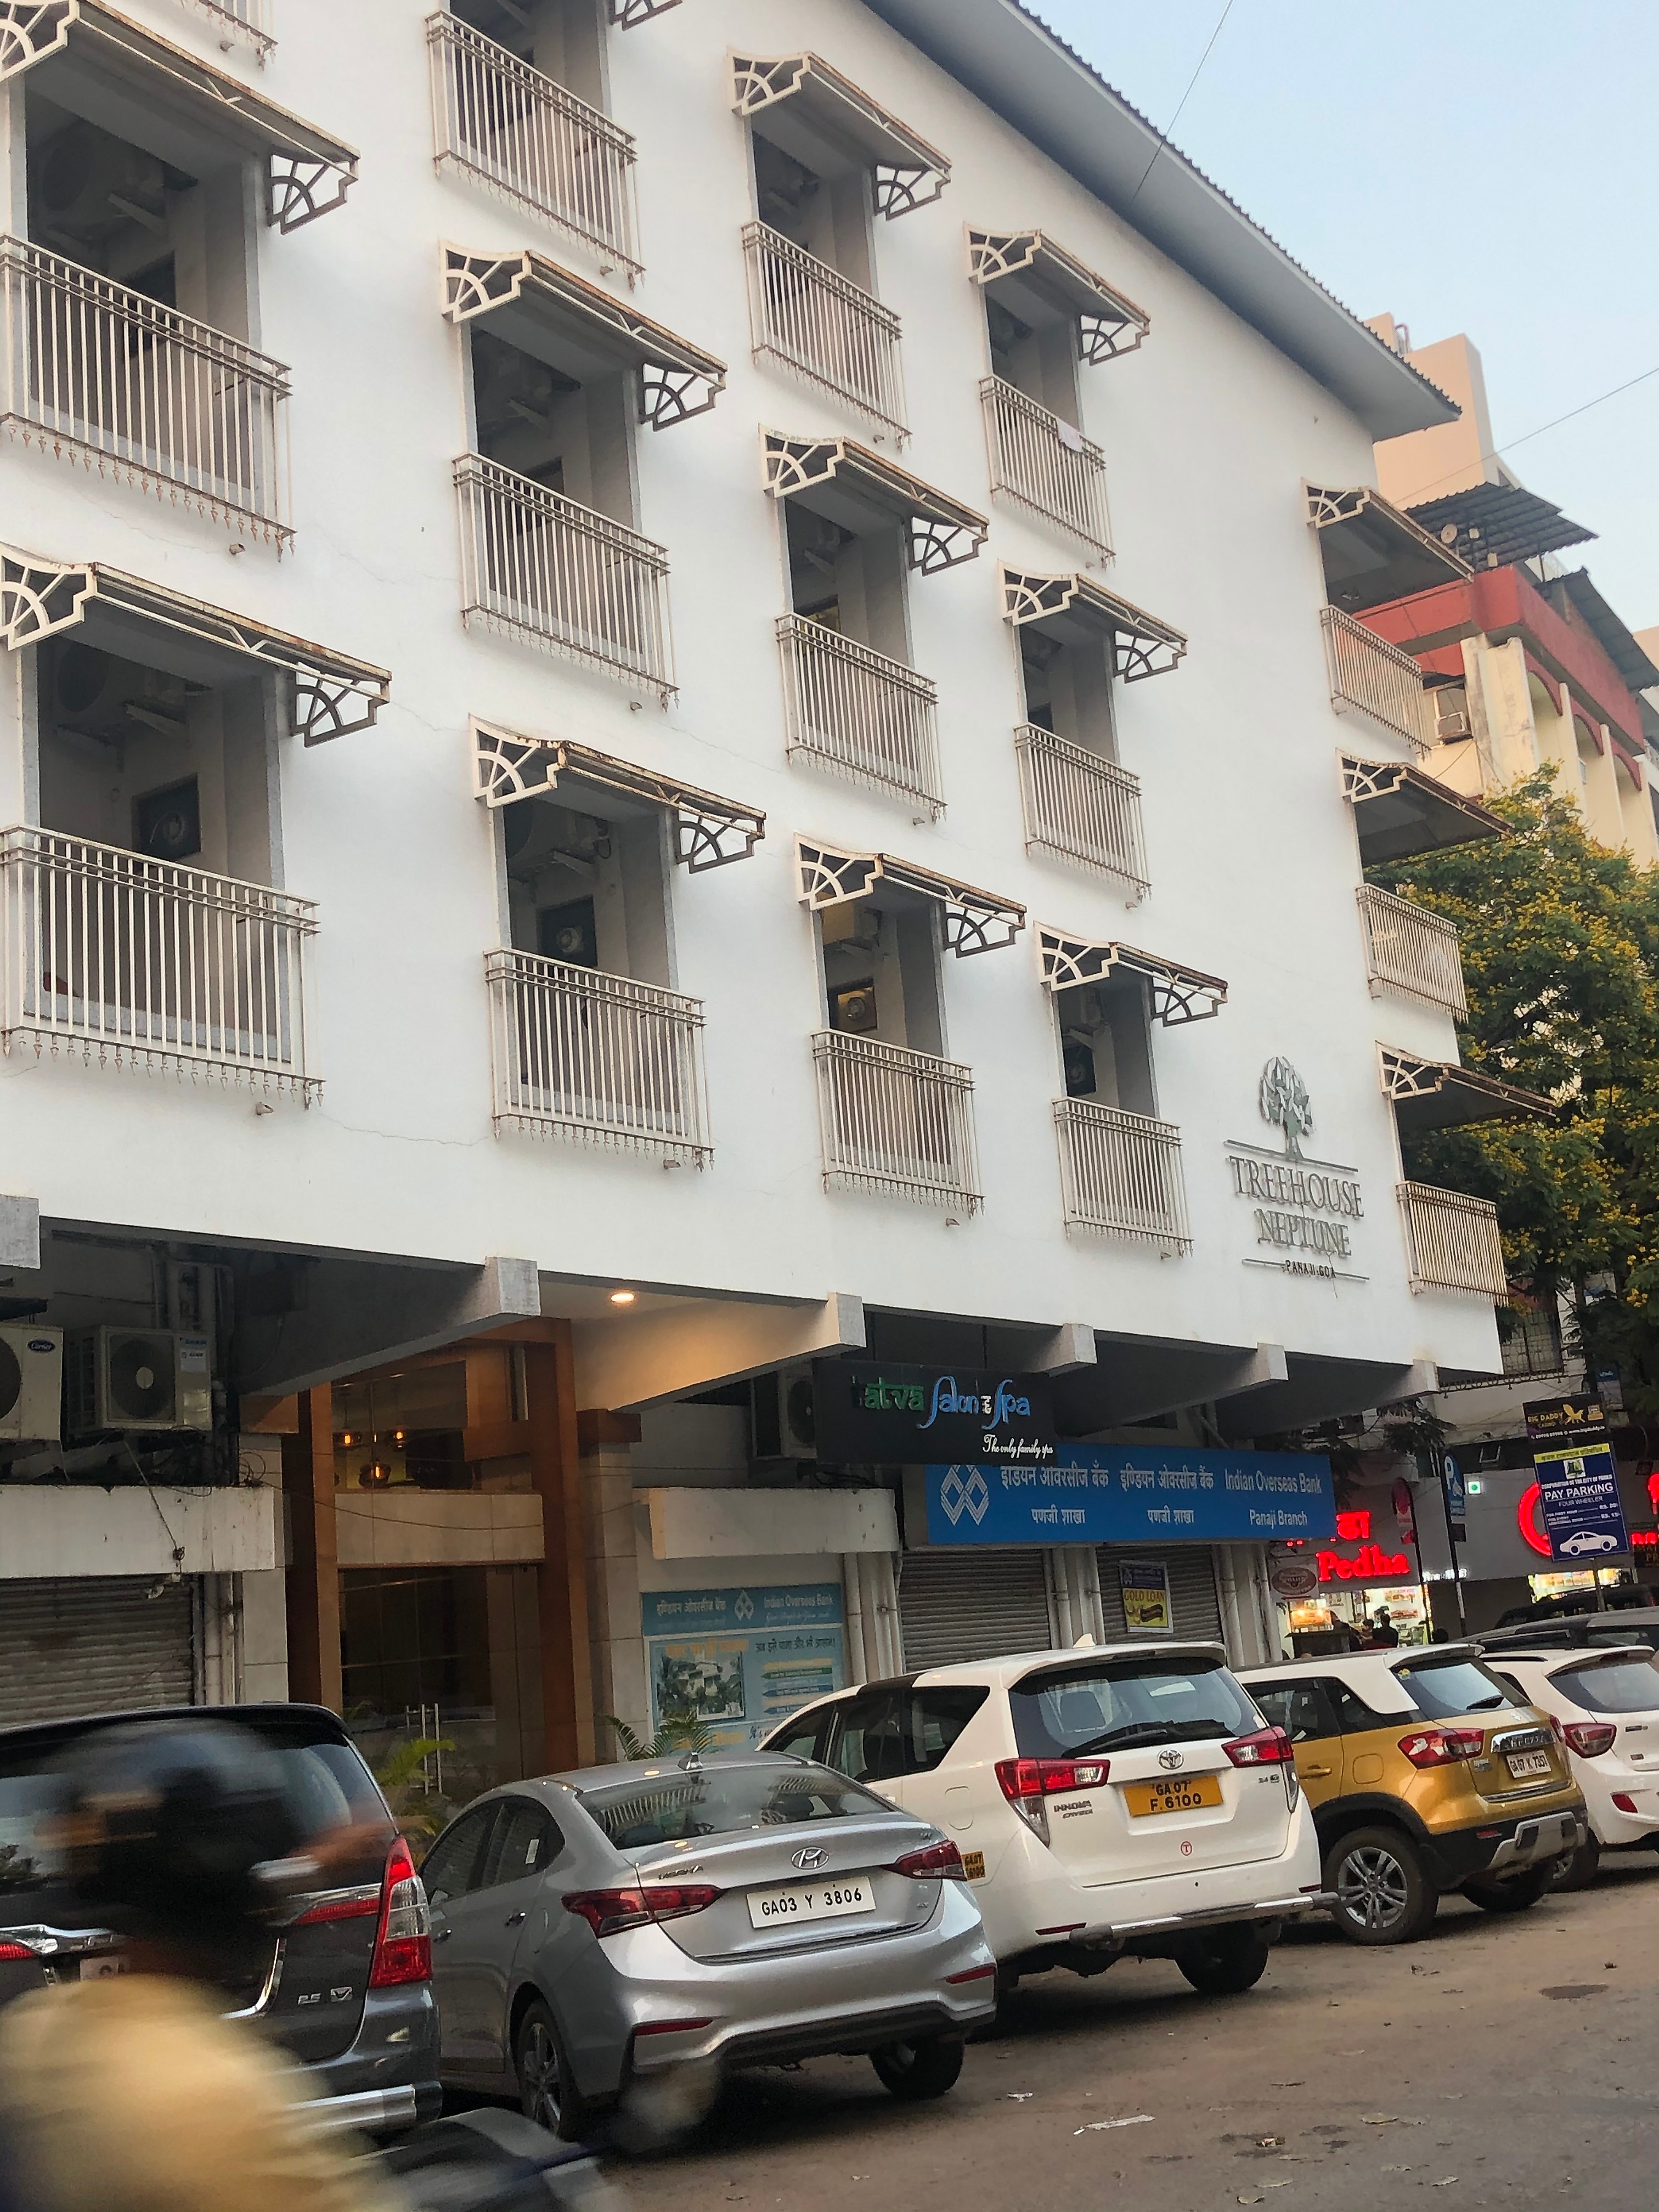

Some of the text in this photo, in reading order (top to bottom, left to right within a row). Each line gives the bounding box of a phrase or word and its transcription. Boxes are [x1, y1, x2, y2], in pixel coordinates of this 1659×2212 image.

[1228, 1155, 1364, 1217] TREEHOUSE
[1254, 1209, 1352, 1257] NEPTUNE
[1540, 1412, 1564, 1421] DADDY
[983, 1434, 1000, 1452] The
[1000, 1438, 1017, 1458] only
[1017, 1438, 1041, 1459] family
[1224, 1469, 1322, 1493] Indian Overseas Bank
[1544, 1482, 1613, 1501] PAY PARKING
[1575, 1496, 1604, 1505] WHEELER
[1031, 1504, 1085, 1525] पणजी शाखा
[1147, 1504, 1194, 1525] पणजी शाखा
[1249, 1509, 1308, 1530] Panaji Branch
[1316, 1544, 1410, 1581] Pedha
[1125, 1590, 1165, 1602] GOLD LOAN
[1054, 1800, 1092, 1813] INNOVA
[761, 1888, 862, 1916] GA03 Y 3806
